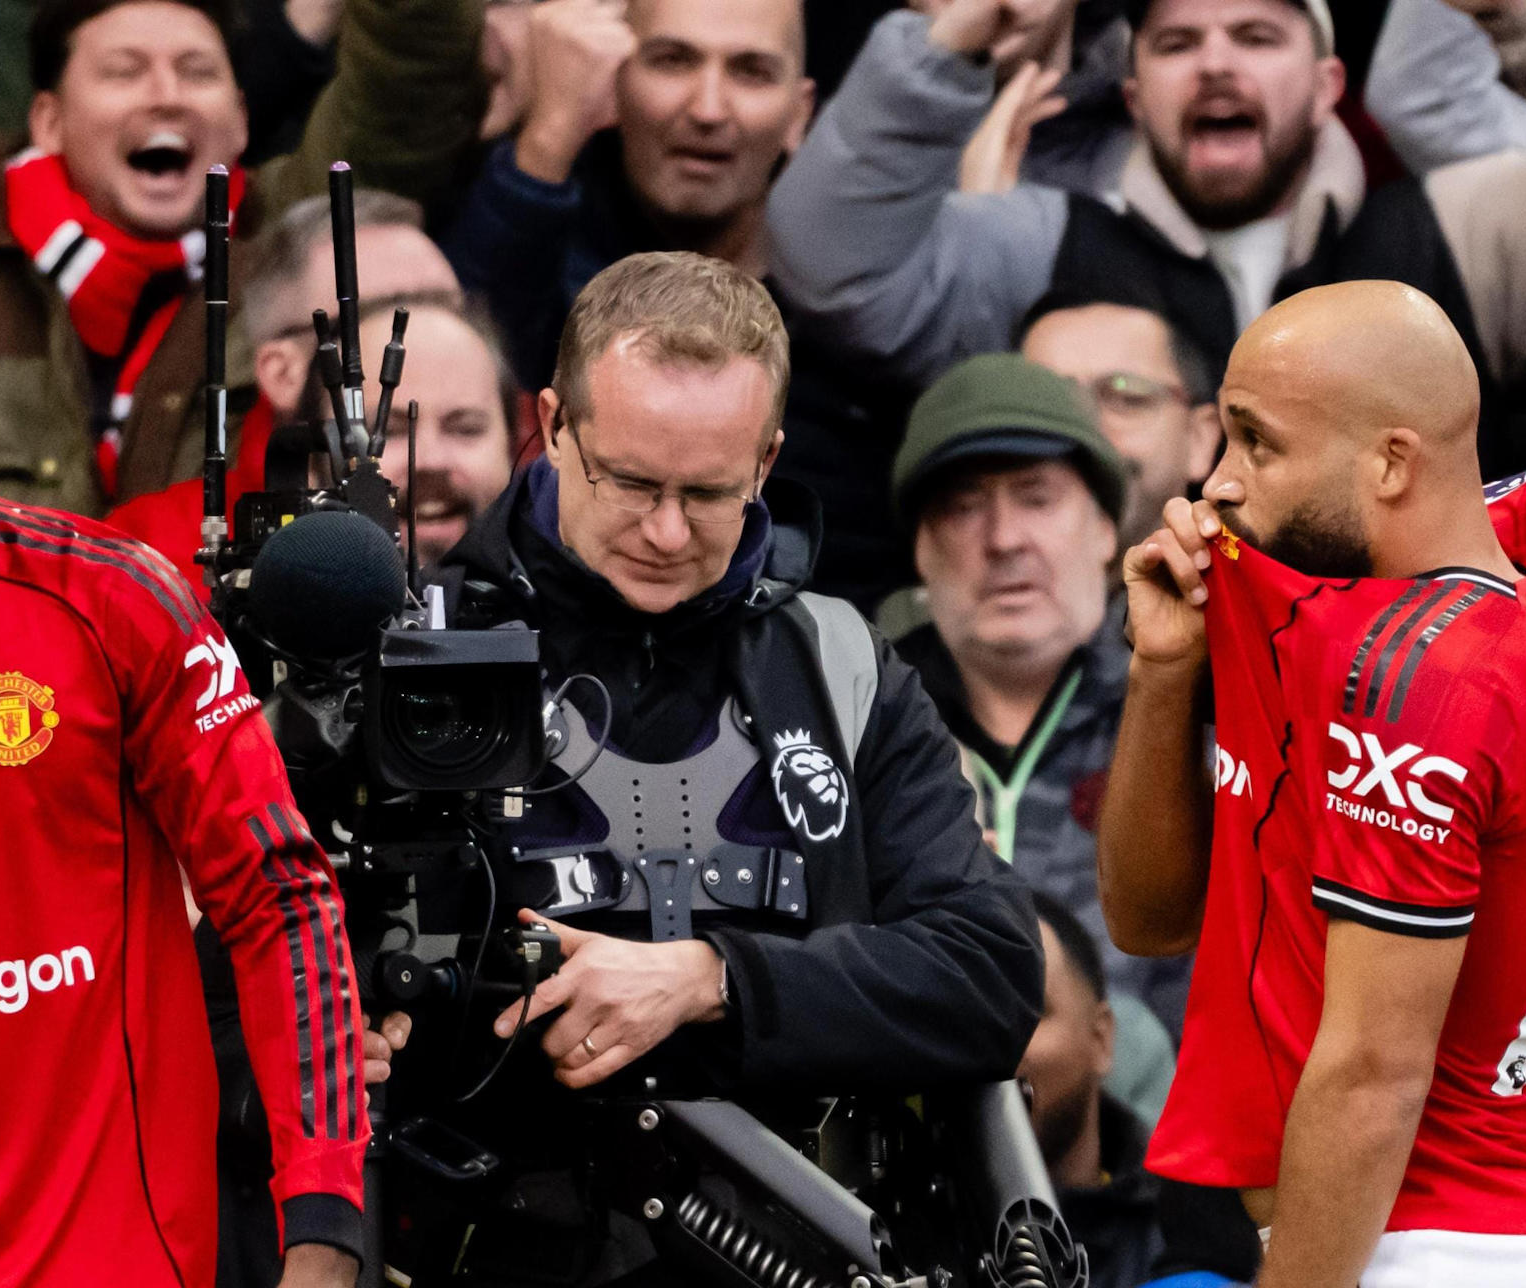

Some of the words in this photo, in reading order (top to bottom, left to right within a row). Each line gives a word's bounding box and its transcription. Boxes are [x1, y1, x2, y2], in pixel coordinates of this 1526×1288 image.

[195, 693, 261, 734] TECHN
[1328, 721, 1468, 823] DXC
[1326, 792, 1451, 844] TECHNOLOGY
